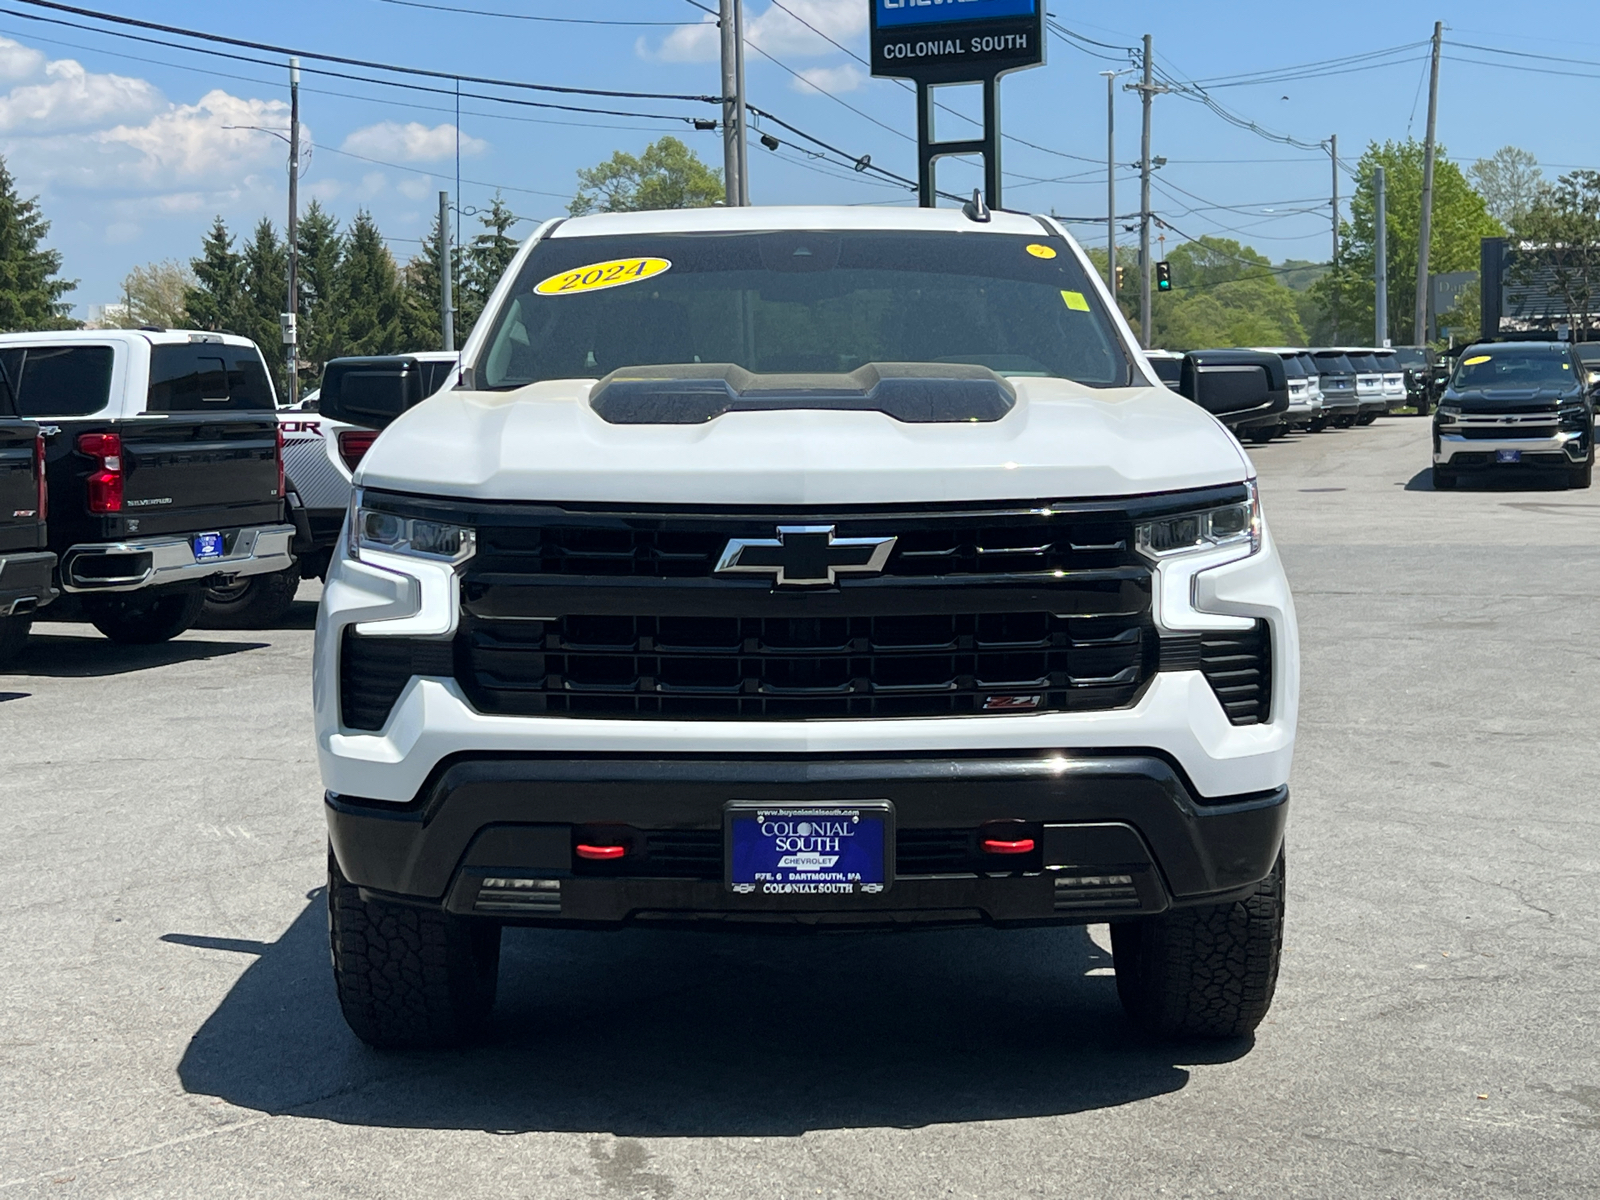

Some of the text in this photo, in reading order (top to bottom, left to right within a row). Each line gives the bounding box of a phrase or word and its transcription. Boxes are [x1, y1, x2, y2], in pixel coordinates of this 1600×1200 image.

[883, 34, 1027, 59] COLONIAL SOUTH
[559, 261, 647, 291] 2024
[982, 695, 1041, 709] Z71
[757, 809, 860, 817] www.buycolonialsouth.com
[761, 822, 854, 836] COLONIAL
[775, 837, 840, 851] SOUTH
[783, 857, 833, 865] CHEVROLET
[789, 873, 845, 881] DARTMOUTH,
[763, 883, 853, 893] COLONIAL SOUTH
